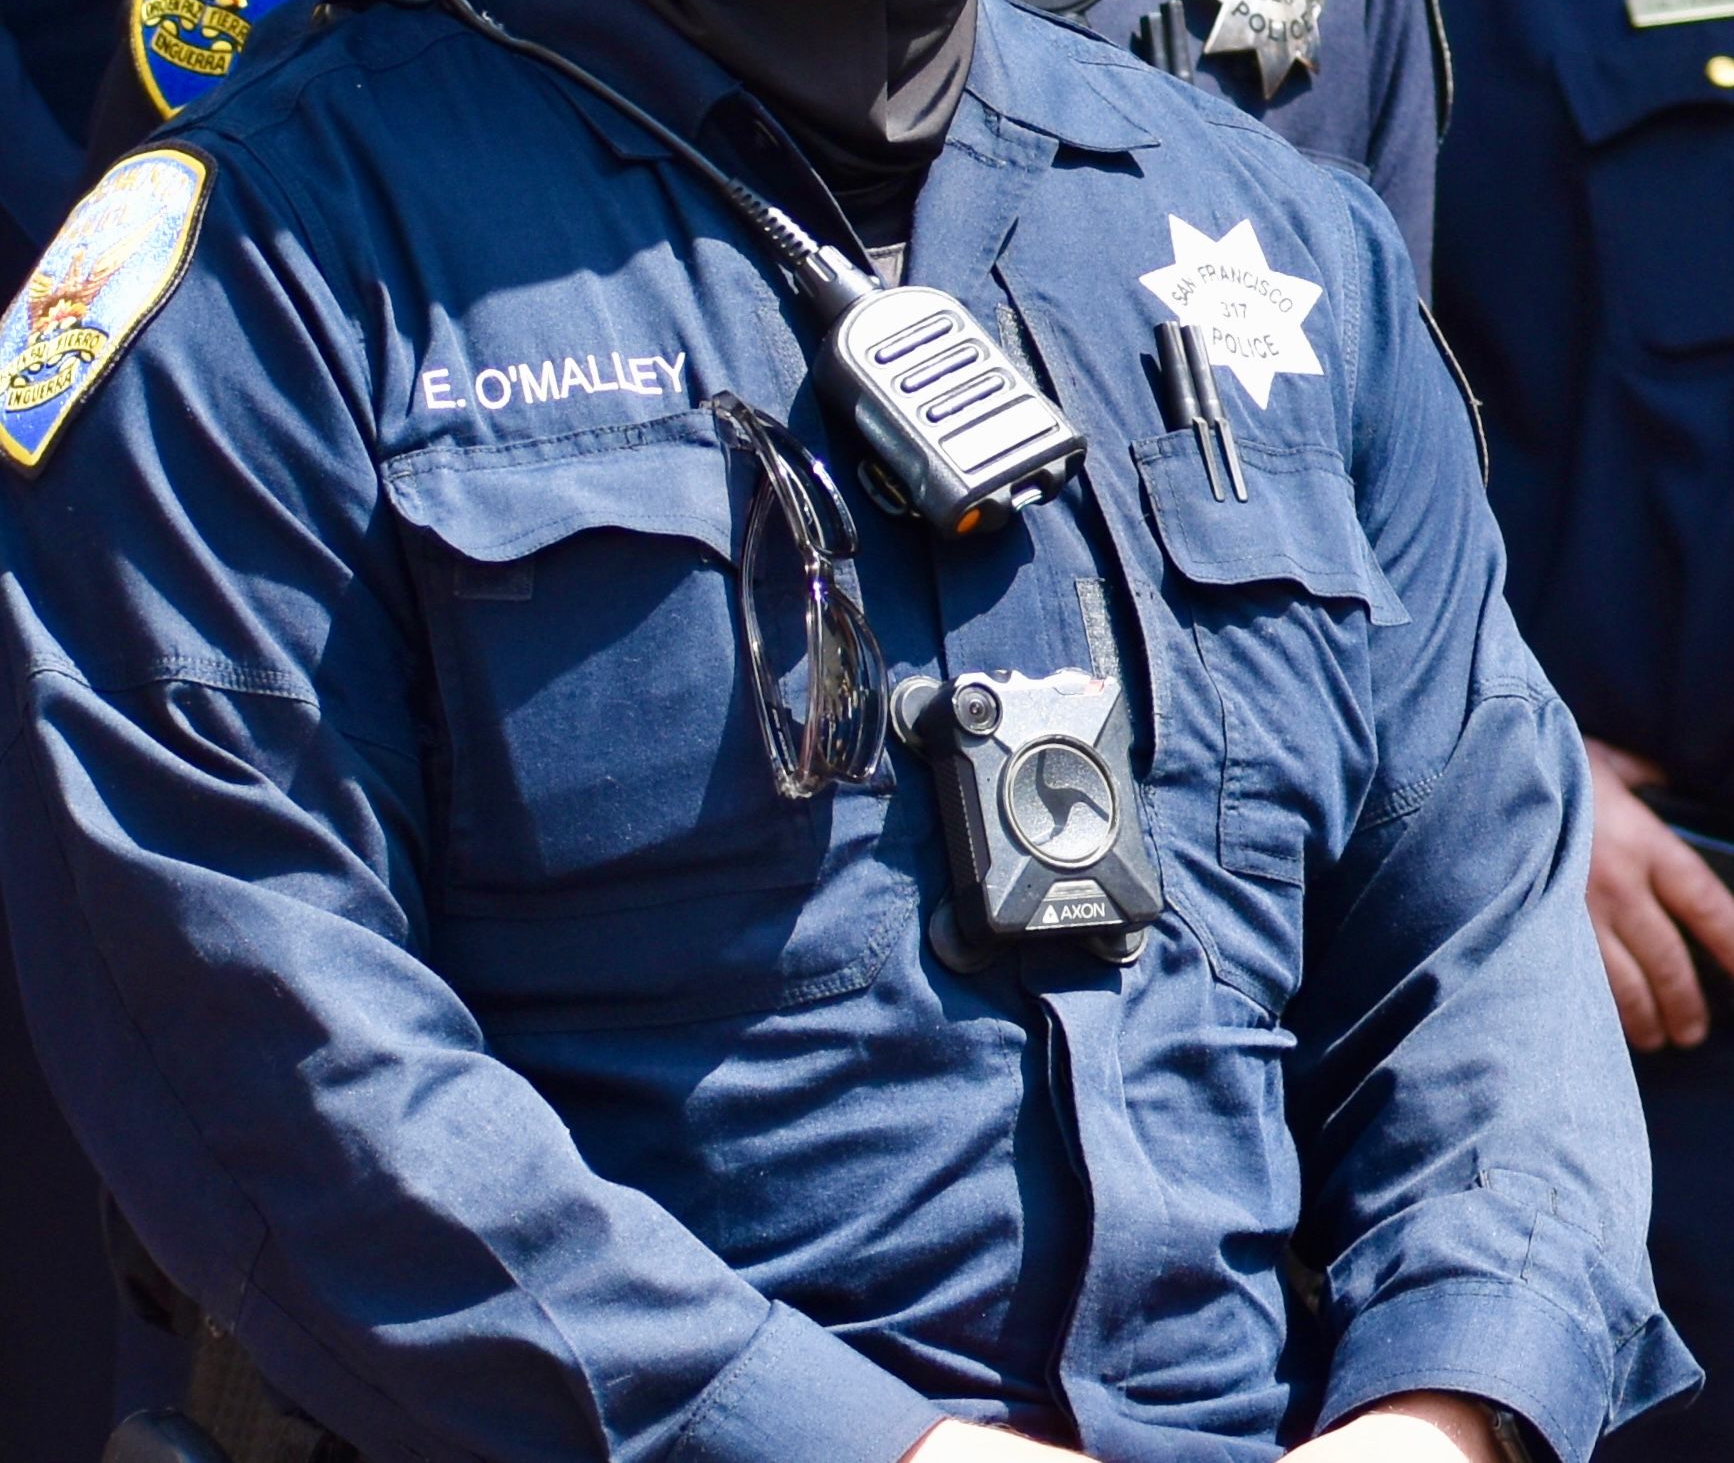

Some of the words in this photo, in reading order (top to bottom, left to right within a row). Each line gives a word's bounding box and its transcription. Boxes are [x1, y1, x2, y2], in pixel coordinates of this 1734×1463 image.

[1231, 0, 1315, 42] POLICE
[1172, 278, 1198, 306] SAN
[1197, 264, 1293, 313] FRANCISCO
[1220, 301, 1247, 319] 317
[1212, 327, 1280, 359] POLICE
[22, 370, 73, 403] GUERRA
[422, 368, 466, 409] E.
[475, 352, 686, 410] O'MALLEY
[1061, 902, 1105, 920] AXON
